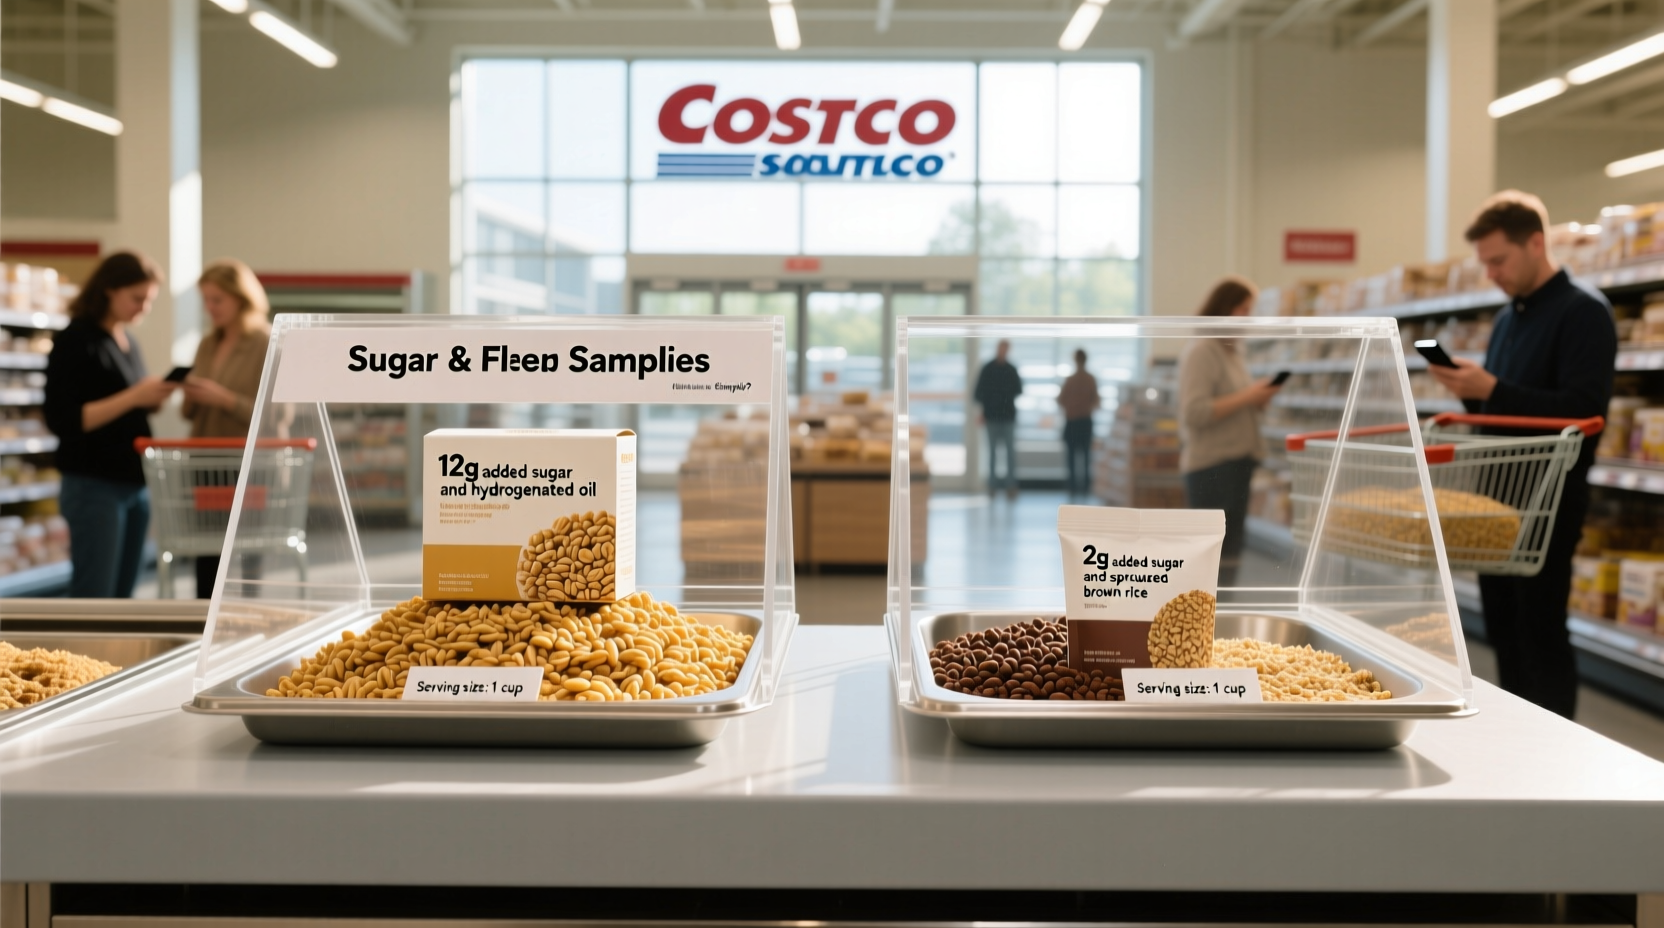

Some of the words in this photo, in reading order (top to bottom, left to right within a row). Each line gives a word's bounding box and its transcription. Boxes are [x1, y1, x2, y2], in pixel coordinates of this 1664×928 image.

[658, 84, 956, 145] COSTCO
[348, 345, 439, 379] Sugar
[448, 345, 472, 372] &
[568, 345, 710, 380] Samplies
[438, 453, 479, 482] 12g
[482, 464, 528, 478] added
[531, 468, 573, 482] sugar
[440, 483, 467, 496] and
[471, 482, 574, 500] hydrogenated
[579, 482, 597, 496] oil
[1083, 544, 1109, 570] 2g
[1112, 555, 1148, 567] added
[1151, 559, 1185, 571] sugar
[1083, 571, 1107, 582] and
[1084, 585, 1121, 598] brown
[417, 681, 460, 696] Serving
[492, 681, 497, 693] 1
[501, 684, 523, 697] cup
[1212, 682, 1219, 694] 1
[1223, 685, 1246, 698] cup
